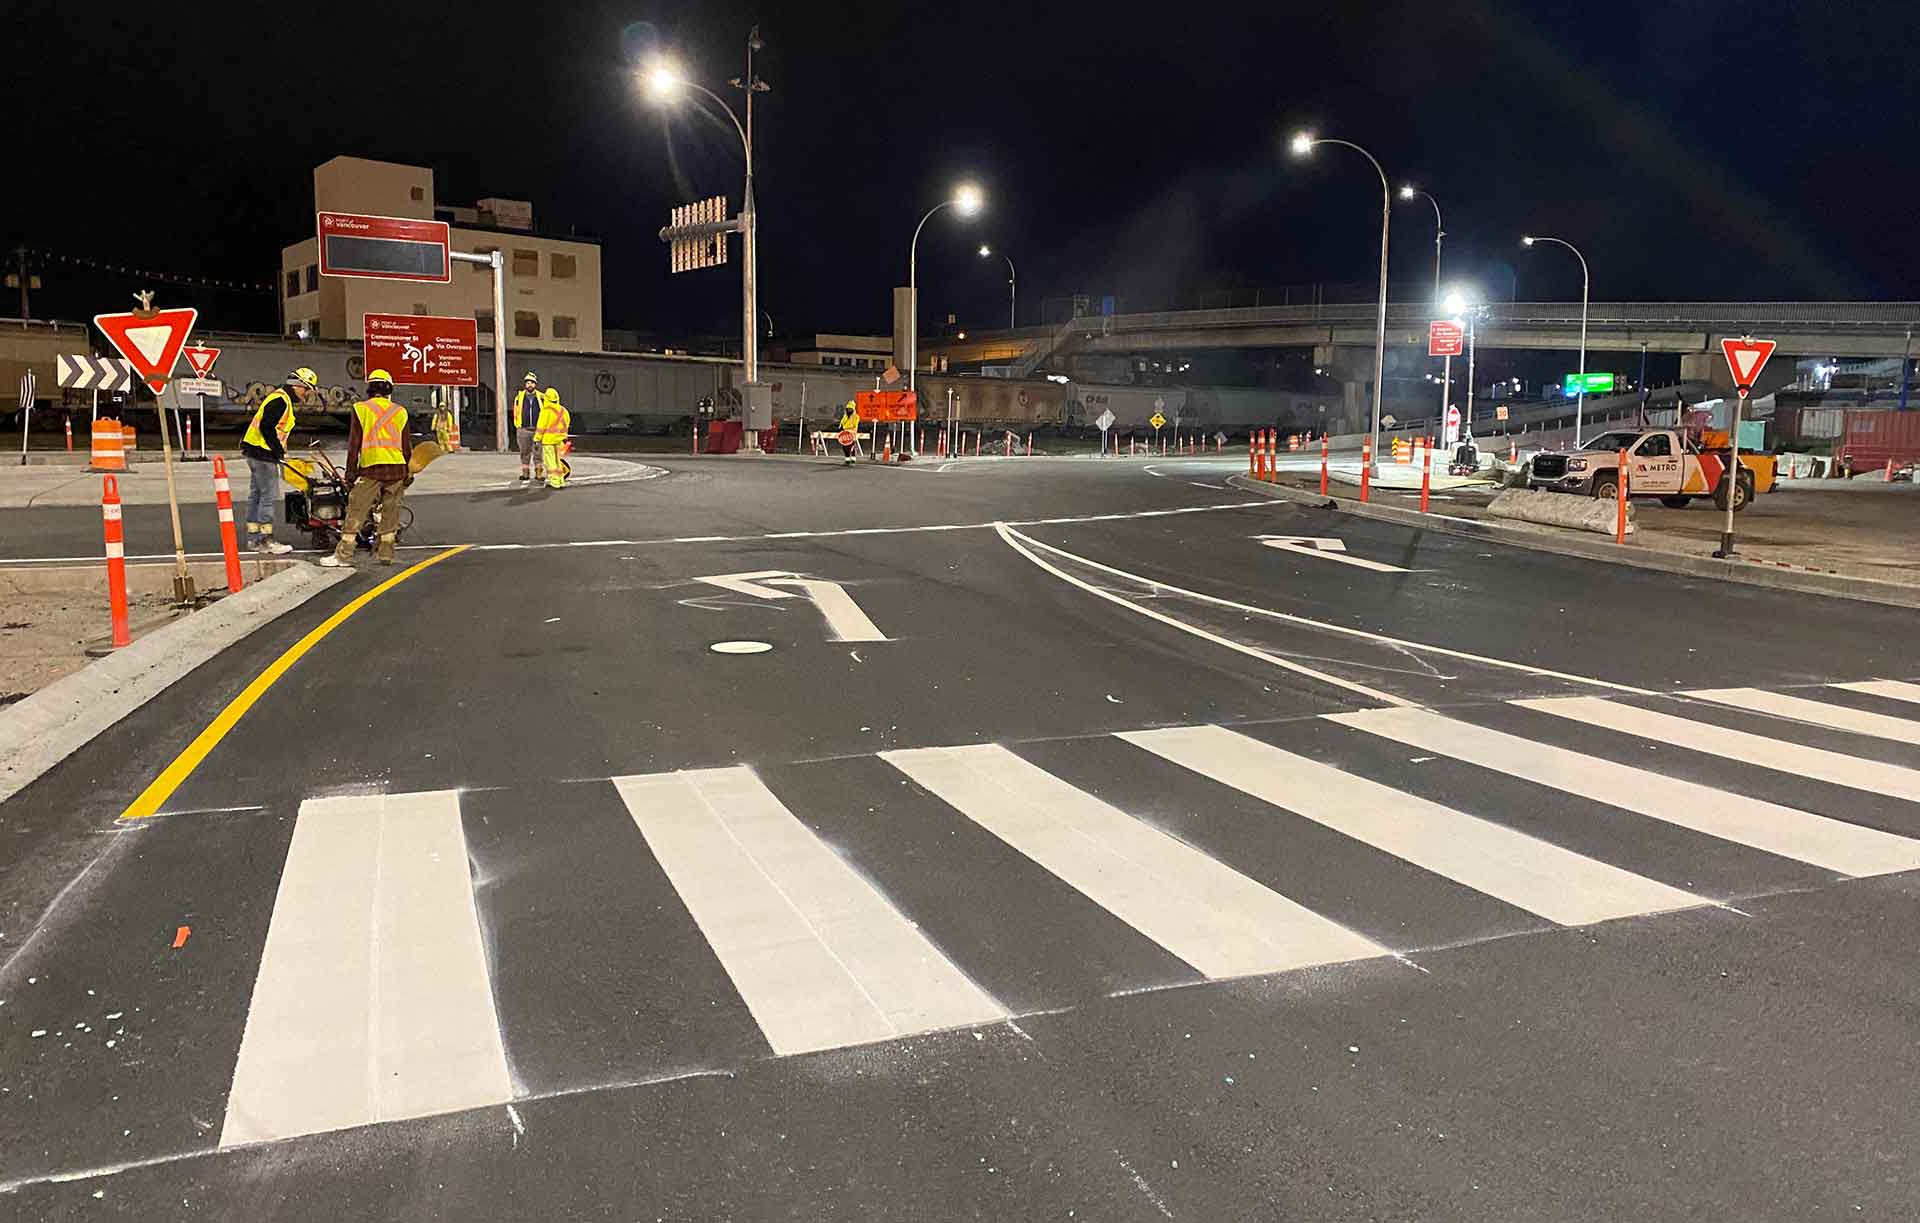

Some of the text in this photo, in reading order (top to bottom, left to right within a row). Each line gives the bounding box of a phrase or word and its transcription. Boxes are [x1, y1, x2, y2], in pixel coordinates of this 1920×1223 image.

[370, 333, 411, 341] Commissioner
[446, 343, 472, 351] Overpass
[439, 367, 459, 375] Rogers
